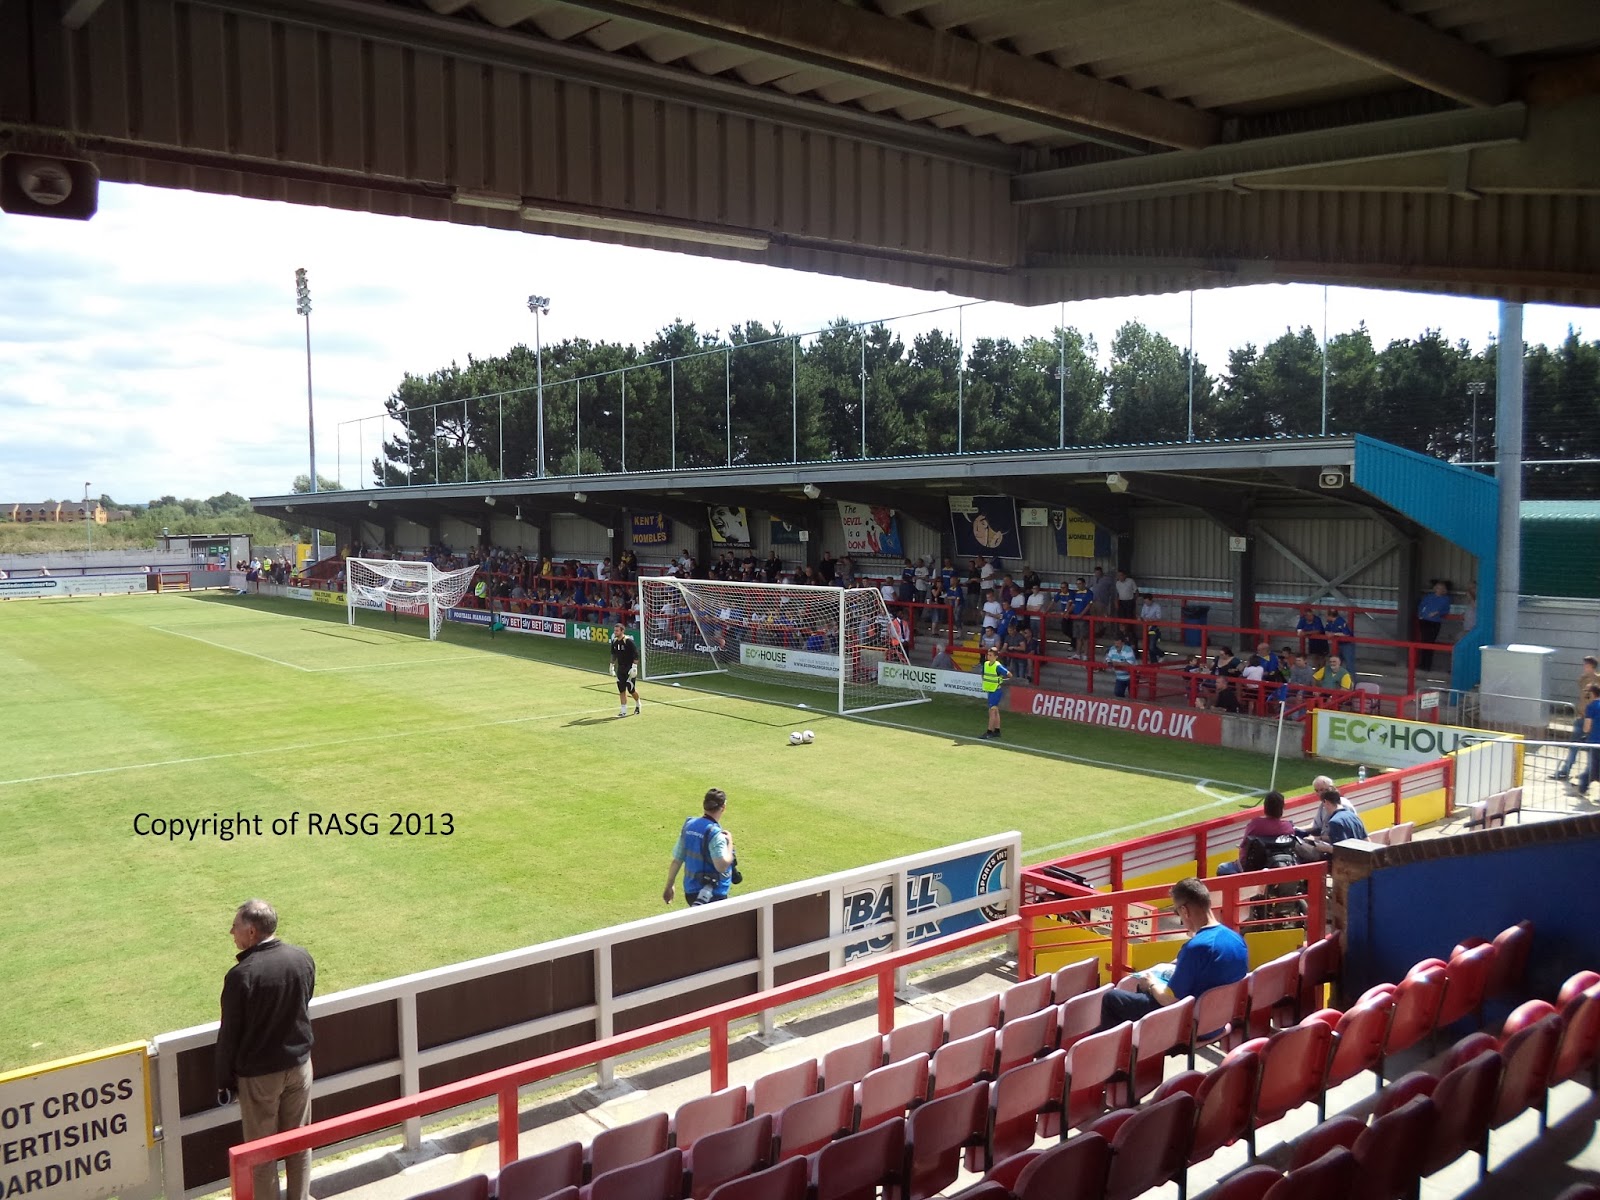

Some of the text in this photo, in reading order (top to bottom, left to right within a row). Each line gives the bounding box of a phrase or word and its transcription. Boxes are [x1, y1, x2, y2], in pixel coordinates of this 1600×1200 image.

[844, 505, 856, 513] The
[634, 515, 654, 525] KENT
[843, 517, 862, 526] DEVIL
[632, 532, 667, 543] WOMBLES
[472, 614, 492, 622] MANAGER
[501, 616, 520, 627] sky BET
[522, 618, 541, 630] sky BET
[543, 621, 564, 633] sky BET
[1031, 692, 1197, 740] CHERRYRED.CO.UK
[979, 858, 997, 894] SPORTS
[42, 1078, 133, 1119] CROSS
